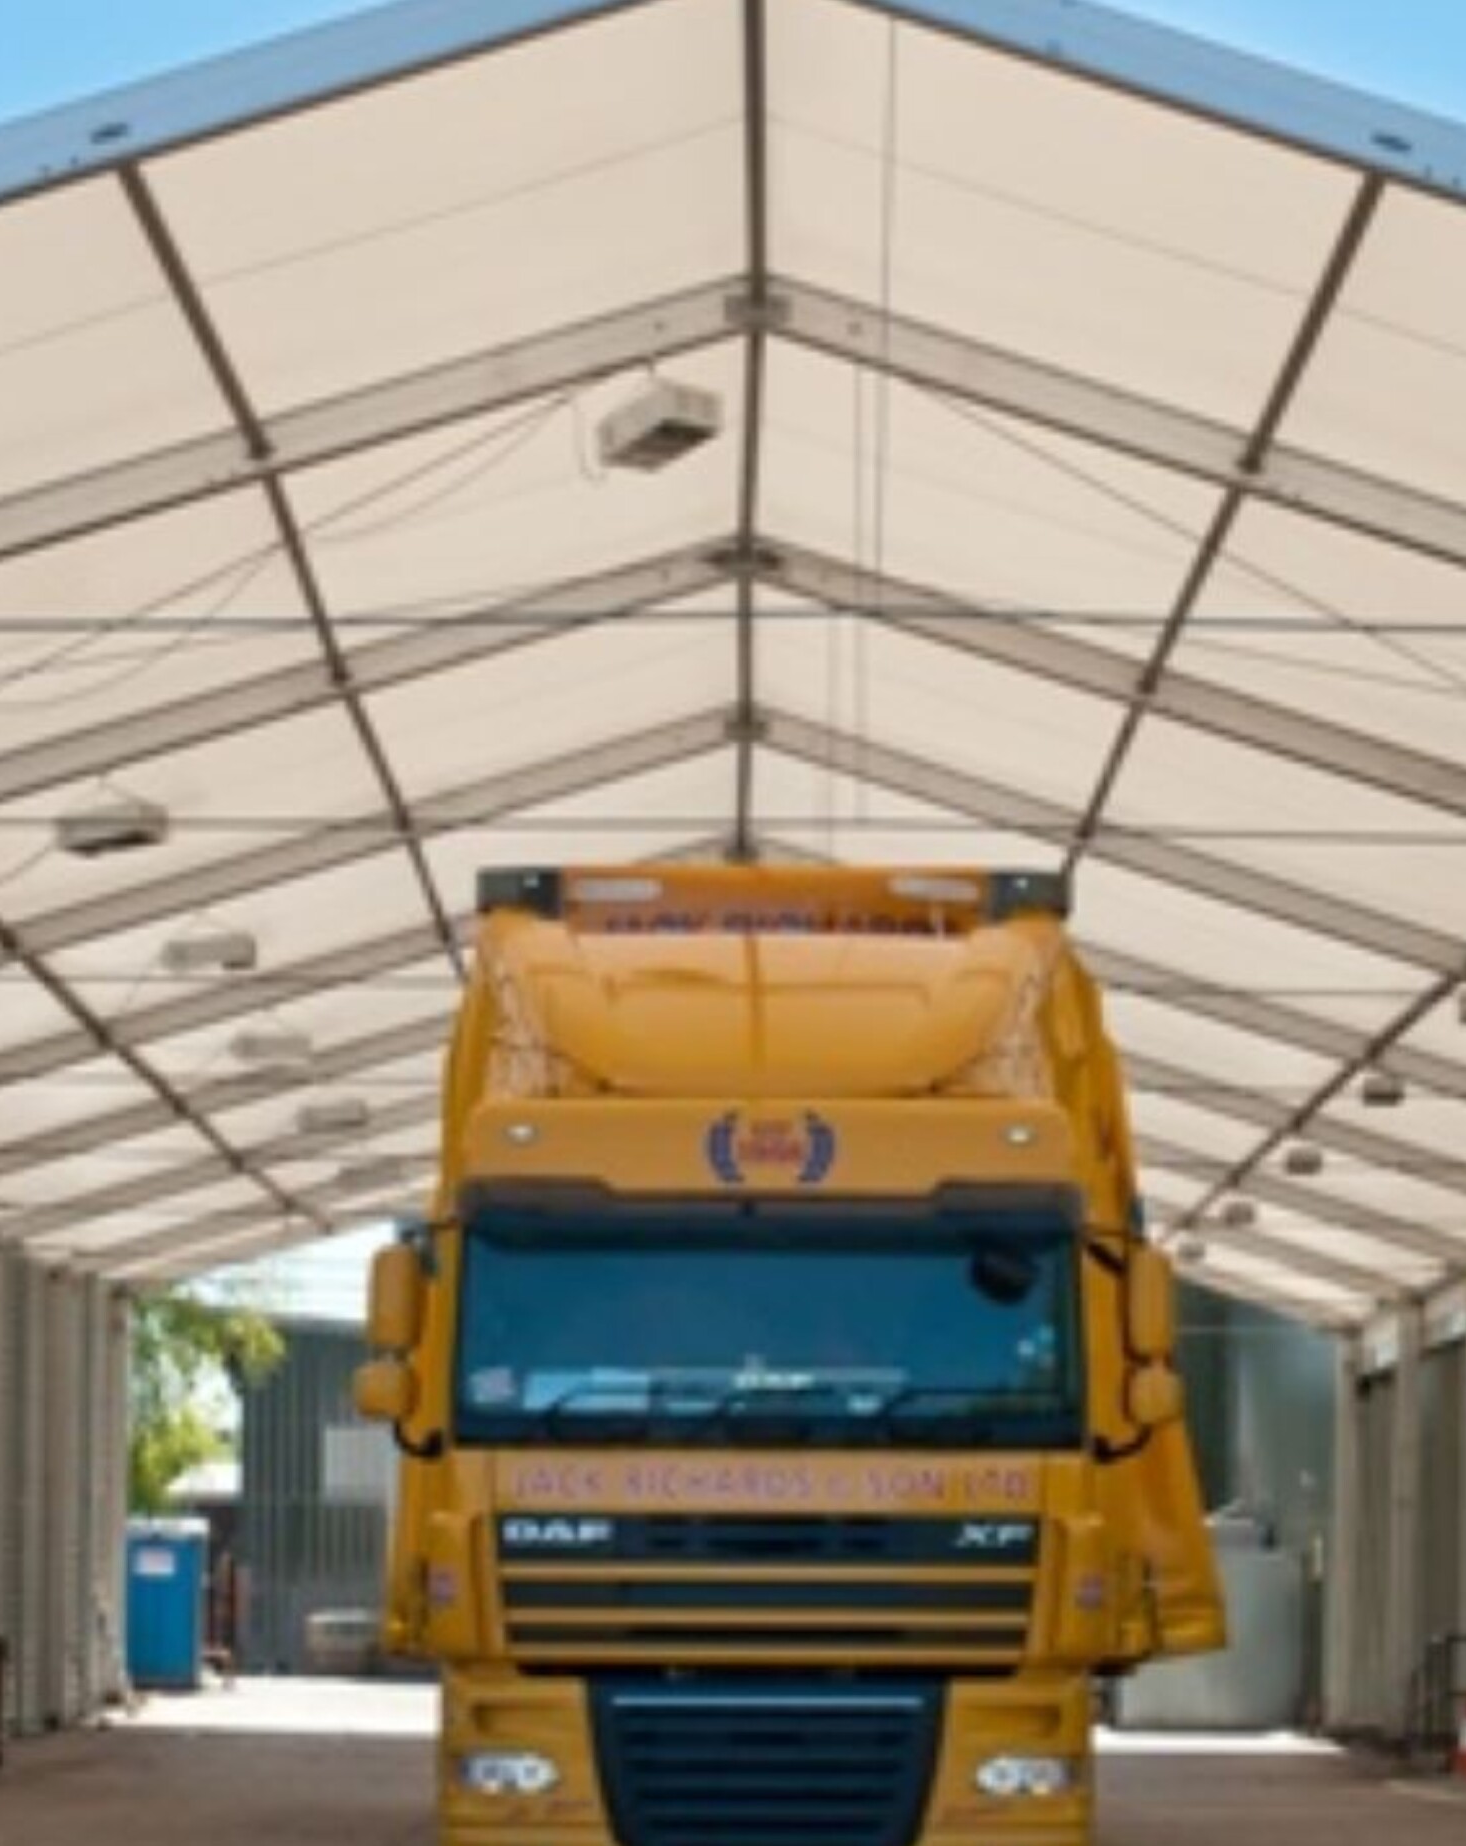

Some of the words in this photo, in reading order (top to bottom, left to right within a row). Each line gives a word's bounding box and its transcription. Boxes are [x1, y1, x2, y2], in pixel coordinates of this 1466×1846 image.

[513, 1462, 605, 1500] JACK
[623, 1462, 814, 1500] RICHARDS
[865, 1464, 947, 1500] SON
[963, 1464, 1029, 1500] LTD
[501, 1517, 615, 1542] DAF
[953, 1523, 1034, 1547] XF
